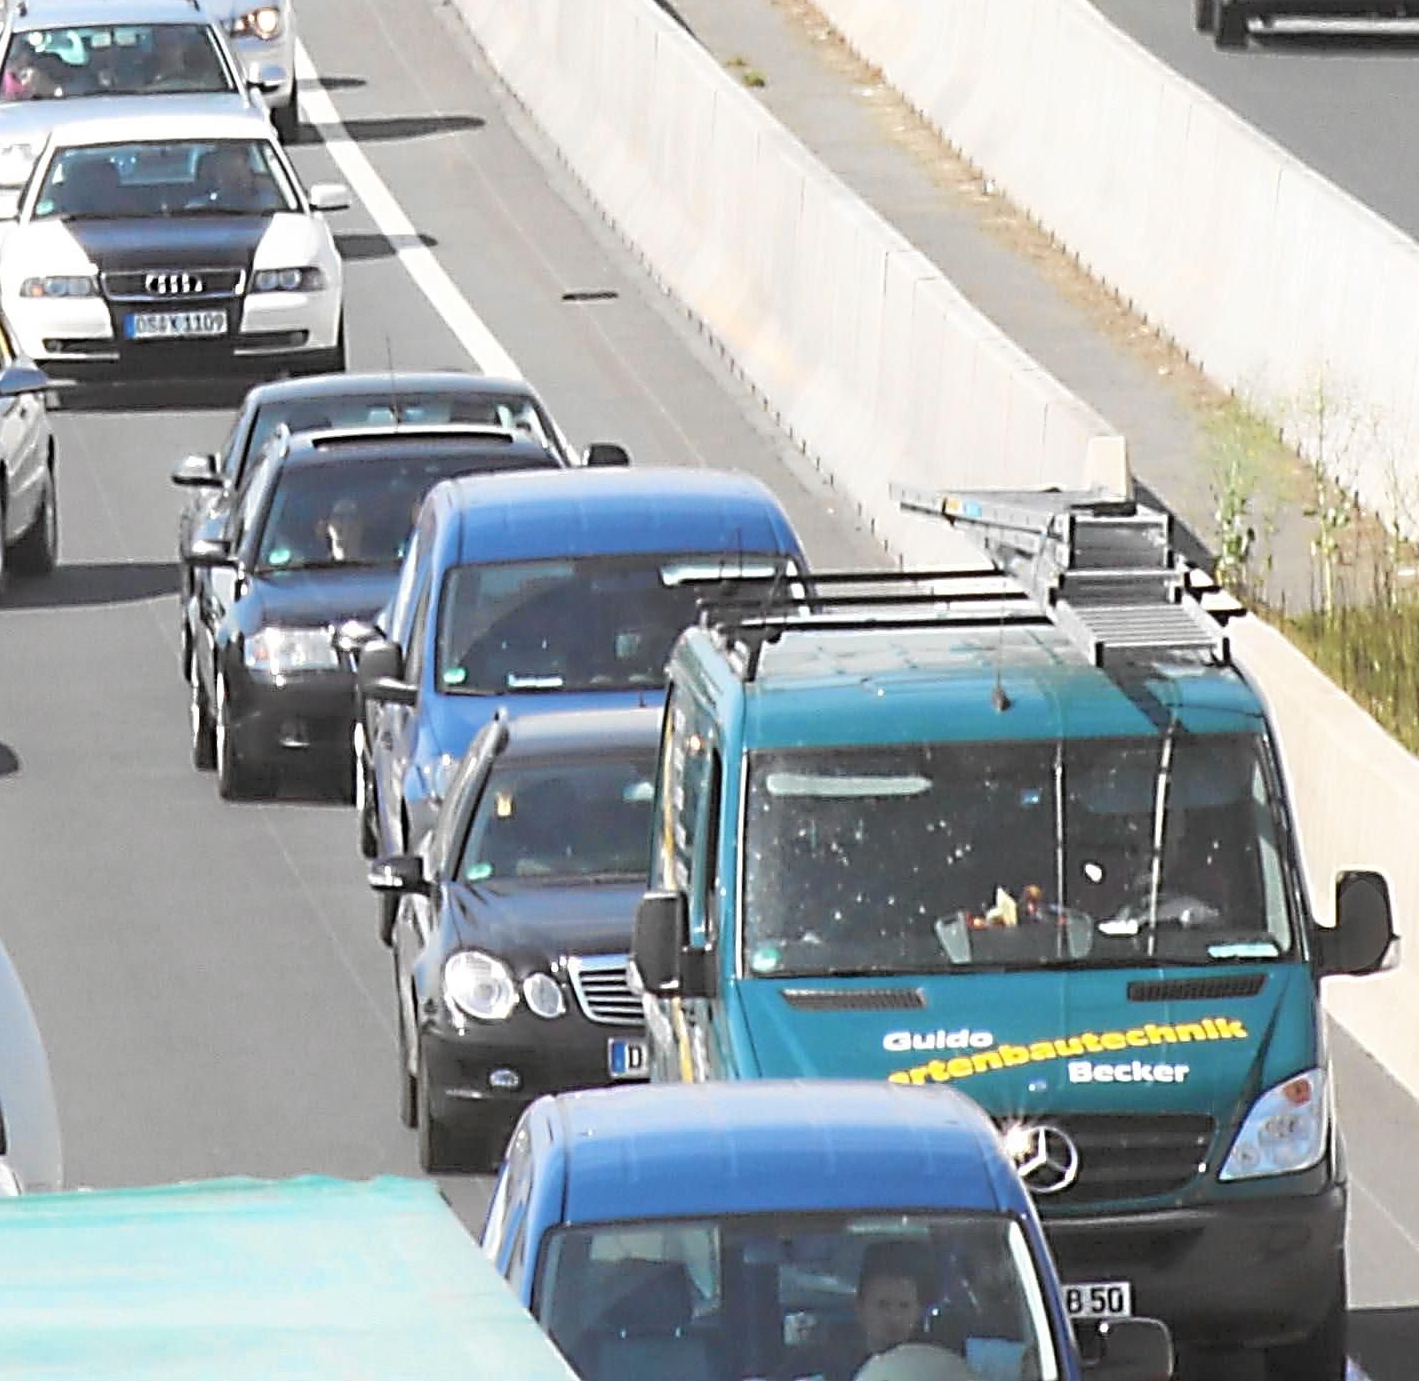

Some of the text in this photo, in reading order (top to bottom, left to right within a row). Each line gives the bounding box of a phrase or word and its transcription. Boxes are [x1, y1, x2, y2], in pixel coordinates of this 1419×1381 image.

[883, 1029, 993, 1052] Guido
[628, 1044, 642, 1069] D
[1068, 1060, 1190, 1083] Becker
[1091, 1286, 1124, 1313] 50
